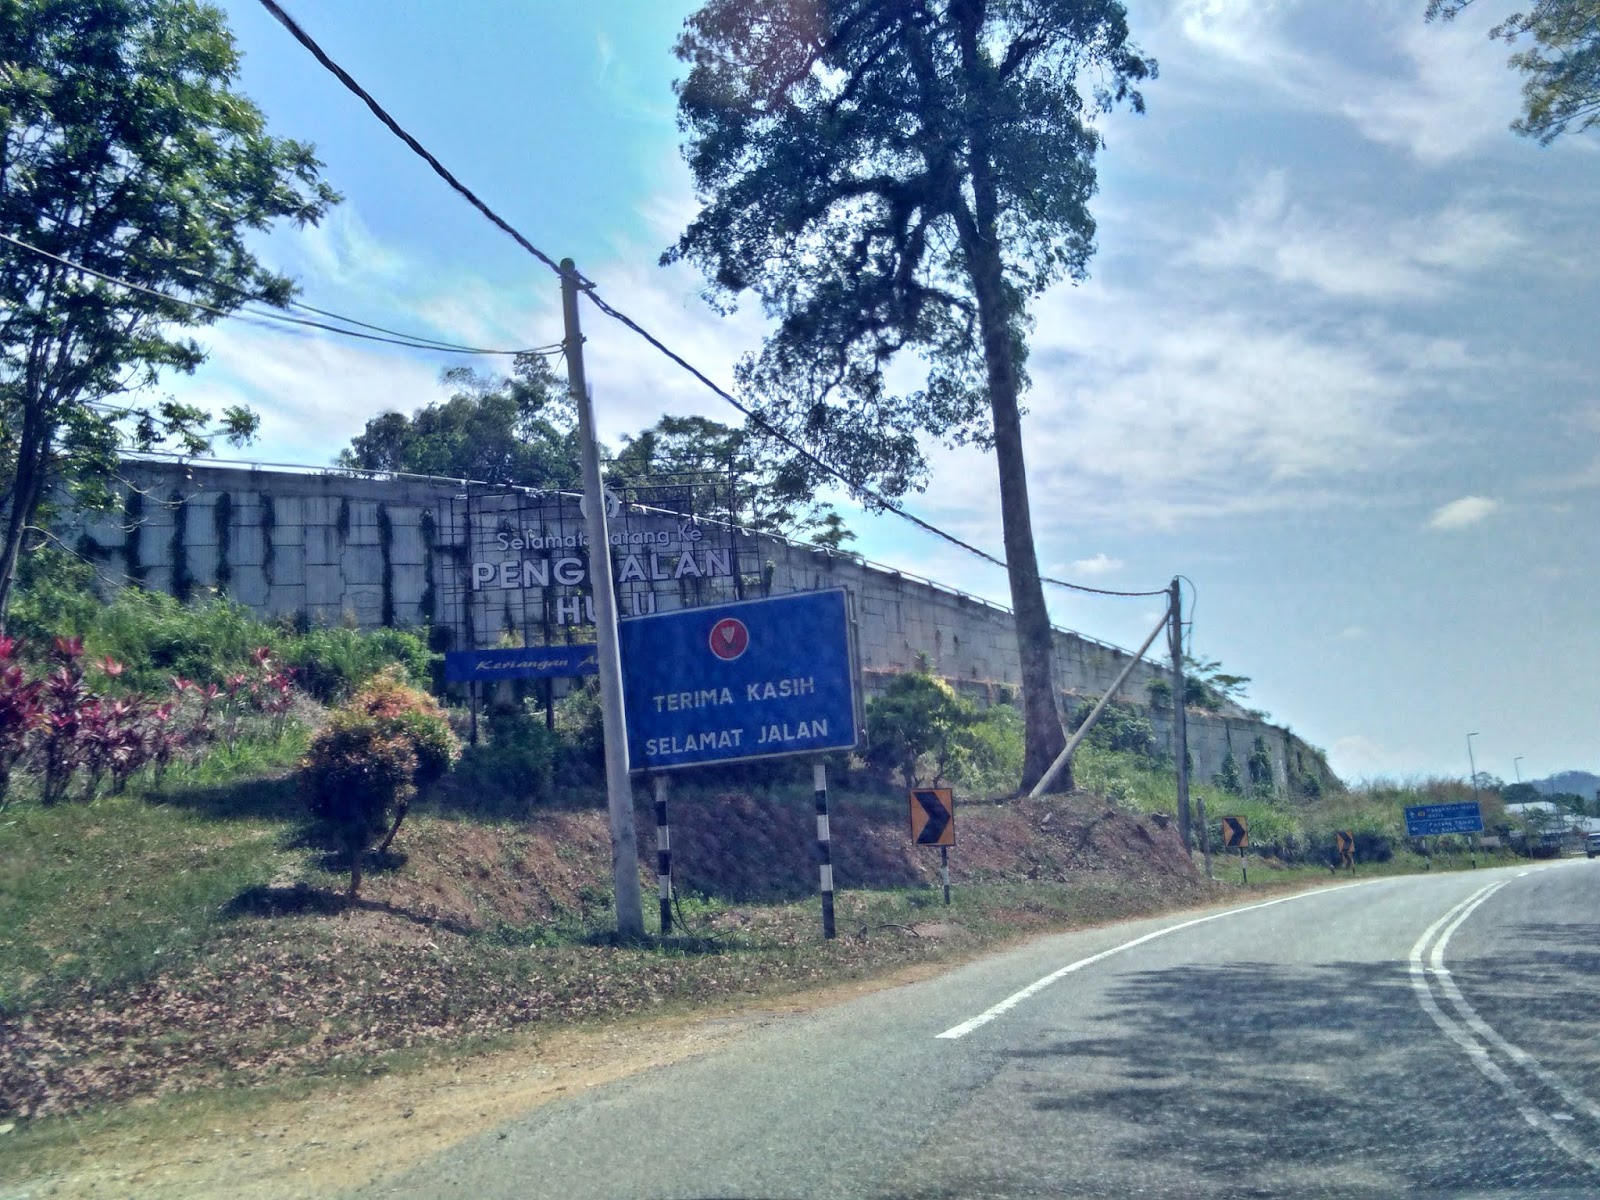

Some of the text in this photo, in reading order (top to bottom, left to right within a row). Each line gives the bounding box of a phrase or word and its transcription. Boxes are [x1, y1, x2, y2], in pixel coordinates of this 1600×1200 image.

[497, 523, 702, 551] Selamat atang Ke
[471, 549, 732, 591] PENGALAN
[556, 591, 658, 625] HU
[653, 676, 815, 713] TERIMA KASIH
[645, 718, 829, 757] SELAMAT JALAN
